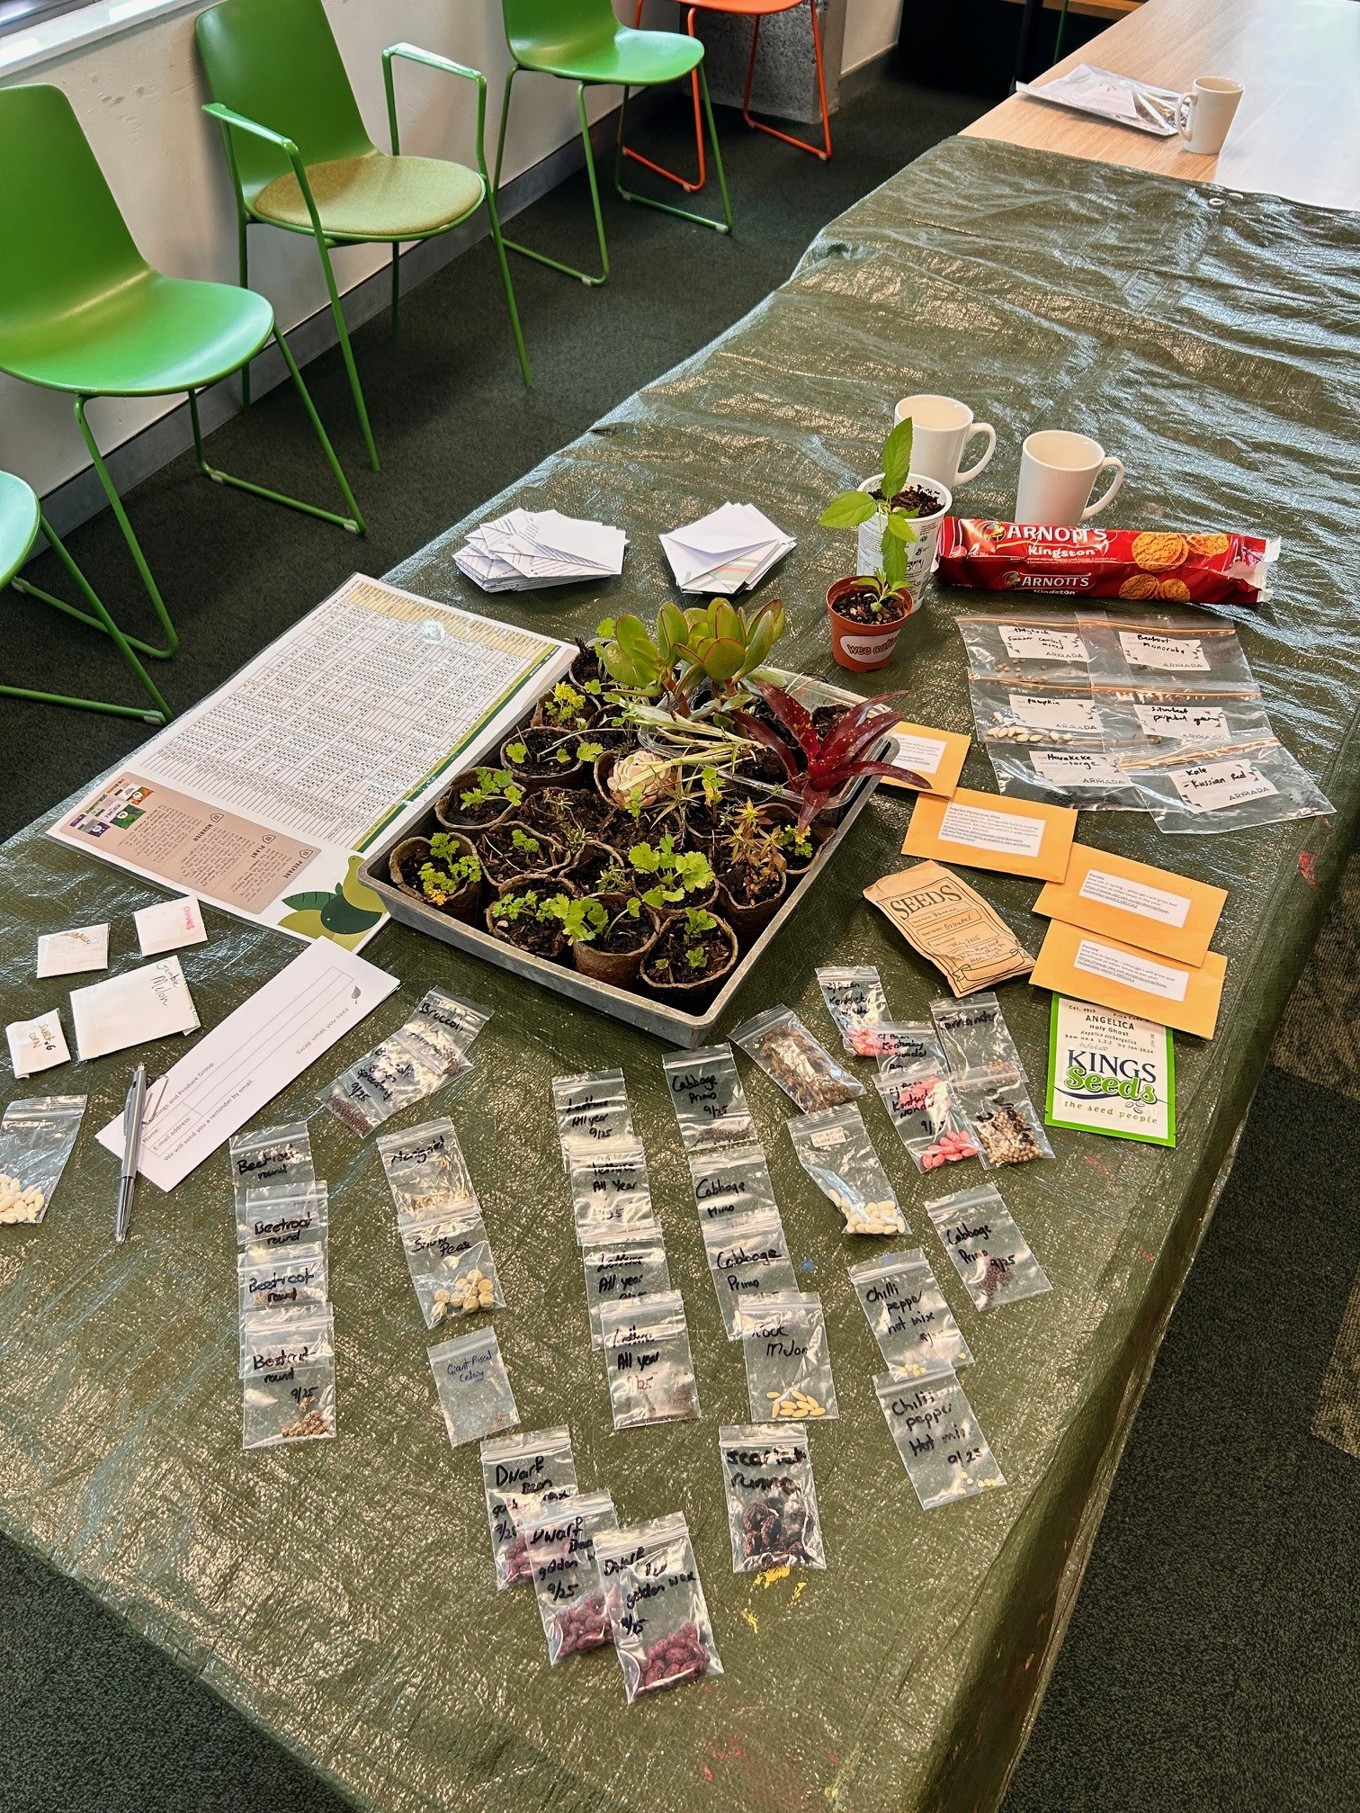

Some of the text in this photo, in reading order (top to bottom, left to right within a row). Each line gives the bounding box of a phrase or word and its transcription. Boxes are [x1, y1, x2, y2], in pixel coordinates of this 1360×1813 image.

[1028, 544, 1096, 559] Kingston
[1021, 576, 1090, 587] ARNOTT'S
[1046, 651, 1084, 659] ARMADA
[1056, 723, 1098, 731] ARMADA
[1083, 778, 1126, 786] ARMADA
[1229, 786, 1271, 801] ARMADA
[890, 884, 963, 921] SEEDS
[296, 1007, 349, 1056] Swap what you need
[1086, 1015, 1135, 1030] ANGELICA
[1089, 1024, 1129, 1036] Holy Ghost
[1067, 1049, 1157, 1083] KINGS
[169, 1062, 215, 1105] and Produce Group
[672, 1074, 718, 1093] Cabbage
[1064, 1065, 1158, 1105] Seeds
[1064, 1100, 1158, 1124] the seed people
[163, 1152, 175, 1162] We
[174, 1142, 186, 1155] will
[184, 1131, 198, 1145] send
[196, 1122, 208, 1135] you
[209, 1098, 233, 1121] reminder
[231, 1089, 240, 1101] by
[170, 1117, 191, 1136] address
[593, 1180, 607, 1193] All
[695, 1178, 745, 1200] Cabbage
[255, 1212, 312, 1235] Beetroot
[267, 1230, 301, 1245] round
[947, 1222, 992, 1246] Cabbage
[717, 1246, 782, 1270] Cabbage
[249, 1268, 314, 1293] Beetroot
[599, 1274, 617, 1293] All
[727, 1274, 760, 1292] Primo
[866, 1281, 899, 1302] Chilli
[617, 1351, 633, 1370] All
[264, 1367, 294, 1383] round
[290, 1387, 319, 1402] 9/25
[496, 1456, 544, 1487] Dwarf
[530, 1517, 583, 1544] Dwarf
